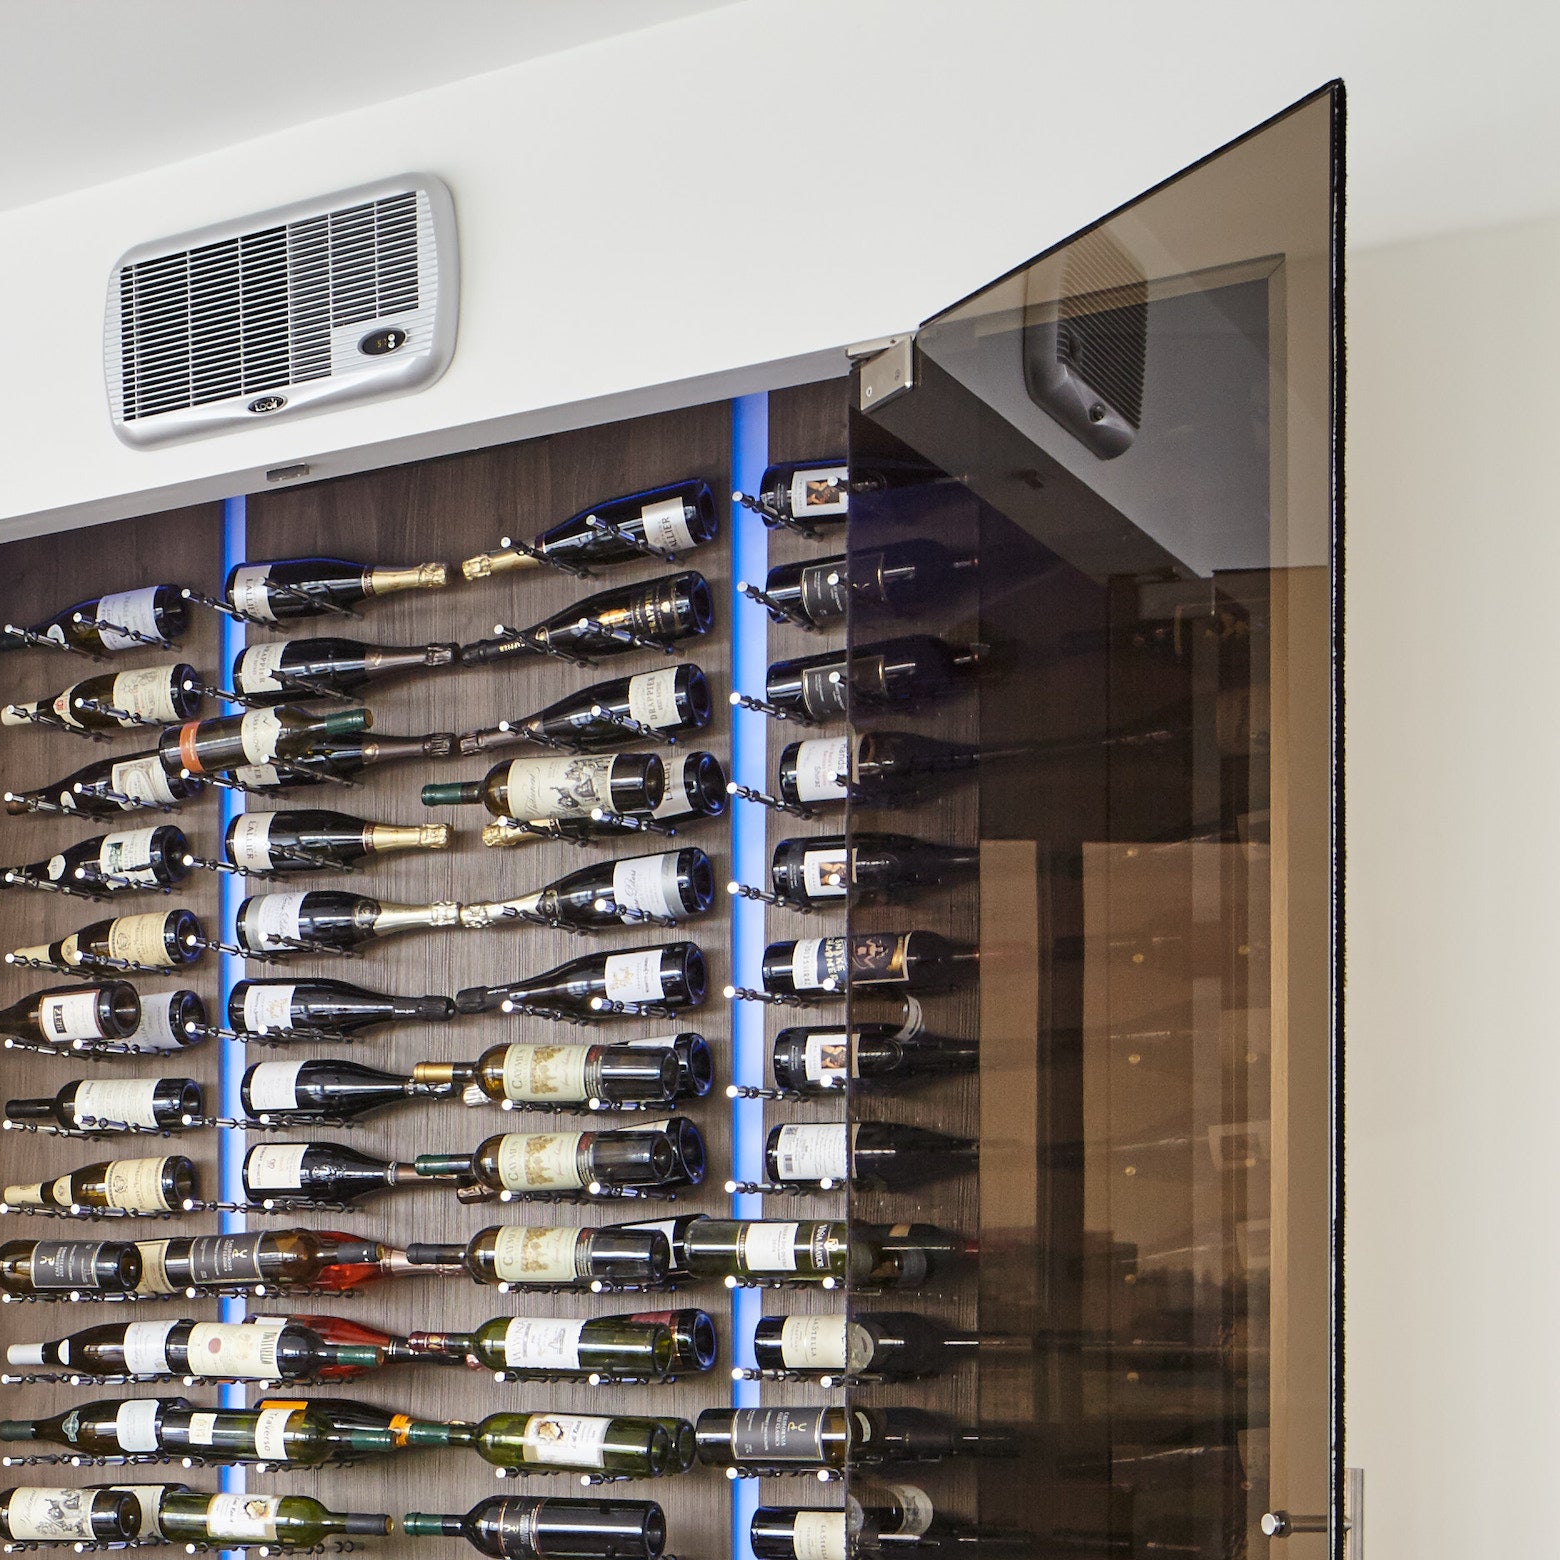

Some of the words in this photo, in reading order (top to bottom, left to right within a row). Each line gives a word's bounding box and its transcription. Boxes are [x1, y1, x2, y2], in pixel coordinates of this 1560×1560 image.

[661, 516, 678, 550] ALLIER
[646, 675, 659, 721] DRAPPIER
[837, 742, 848, 770] Hands
[813, 766, 822, 788] Shiraz
[245, 820, 258, 860] LALLIER
[826, 939, 839, 982] HARMER
[54, 1008, 65, 1031] BETZ
[511, 1049, 527, 1090] CAYMUS
[507, 1140, 521, 1181] CAYMUS
[263, 1411, 279, 1452] Traverso
[778, 1411, 790, 1447] CALIFORNIA
